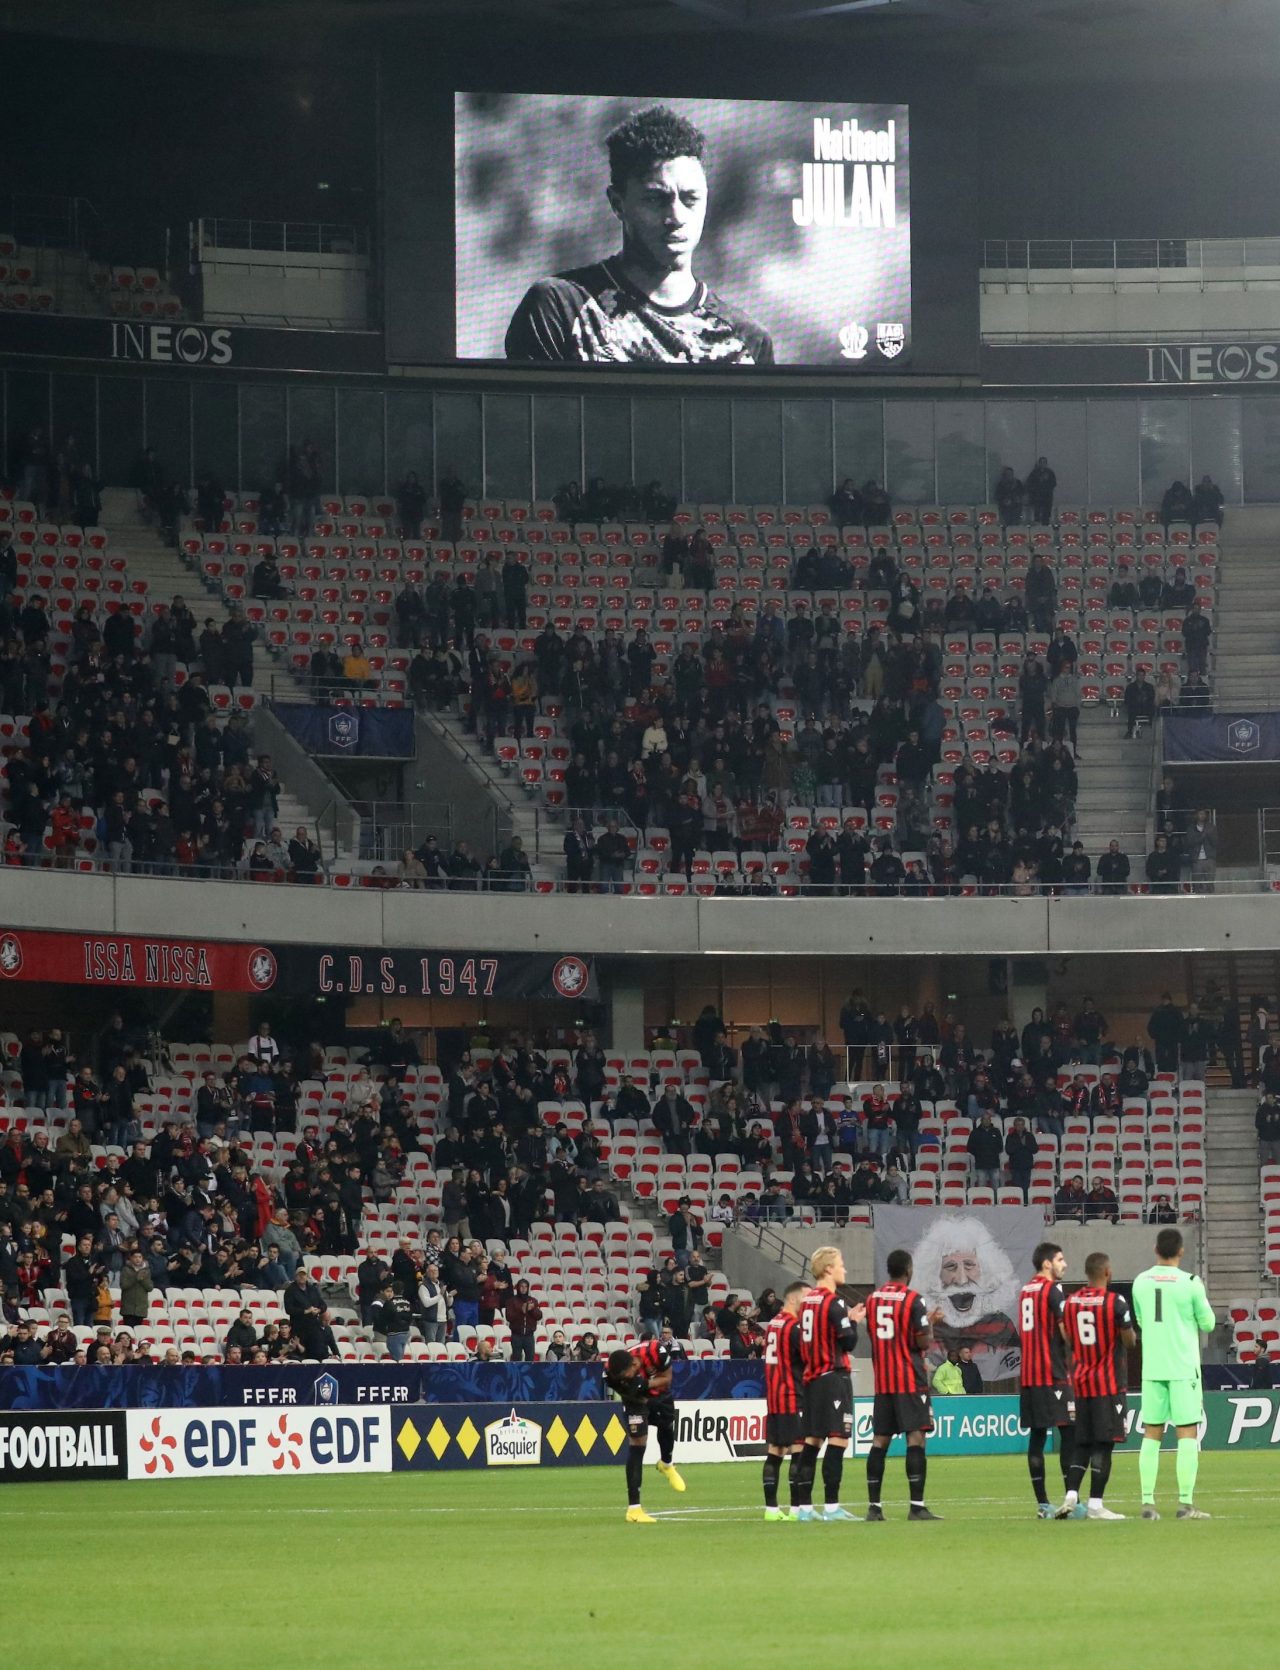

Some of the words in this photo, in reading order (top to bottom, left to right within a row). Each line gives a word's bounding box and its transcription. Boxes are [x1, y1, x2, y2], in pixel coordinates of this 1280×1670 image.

[792, 163, 895, 228] JULAN
[112, 323, 233, 364] INEOS
[1146, 345, 1279, 382] INEOS
[84, 941, 136, 981] ISSA
[145, 944, 212, 986] NISSA
[319, 955, 408, 994] C.D.S.
[421, 958, 499, 996] 1947
[876, 1305, 894, 1339] 5
[1021, 1297, 1034, 1332] 8
[1155, 1288, 1163, 1322] 1
[802, 1309, 814, 1342] 9
[1077, 1310, 1096, 1345] 6
[766, 1331, 778, 1364] 2
[0, 1424, 119, 1469] FOOTBALL
[490, 1433, 538, 1459] Pasquier
